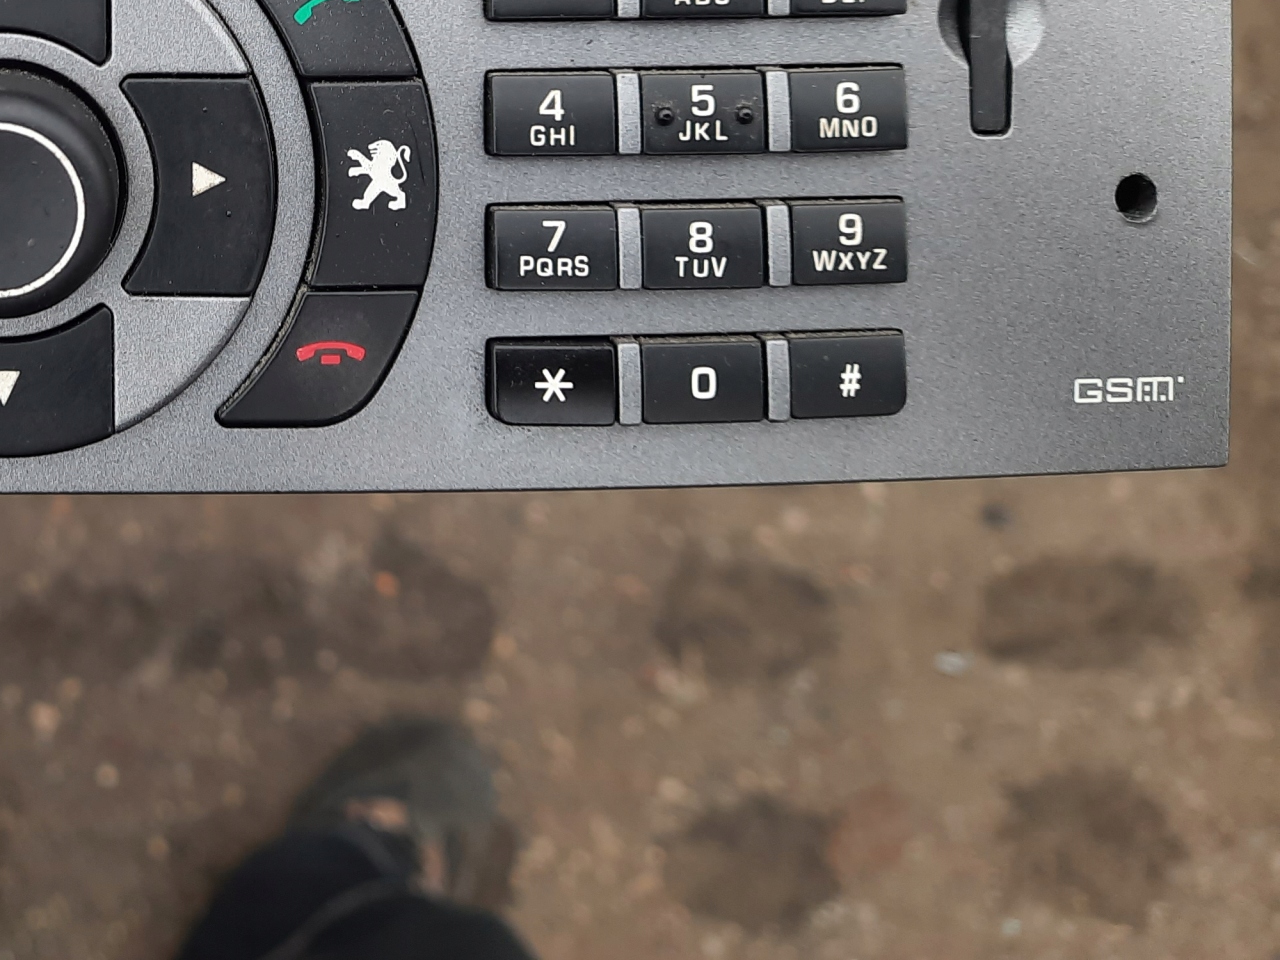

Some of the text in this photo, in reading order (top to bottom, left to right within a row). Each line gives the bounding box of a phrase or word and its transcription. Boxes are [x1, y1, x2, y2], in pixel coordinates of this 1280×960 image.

[539, 89, 565, 121] 4
[691, 84, 715, 117] 5
[836, 81, 860, 114] 6
[529, 124, 575, 147] GHI
[678, 119, 729, 141] JKL
[819, 115, 878, 138] MNO
[542, 220, 566, 253] 7
[688, 221, 714, 254] 8
[838, 213, 863, 246] 9
[519, 255, 589, 277] PQRS
[674, 256, 727, 278] TUV
[812, 248, 888, 272] WXYZ
[1073, 375, 1185, 404] GSM
